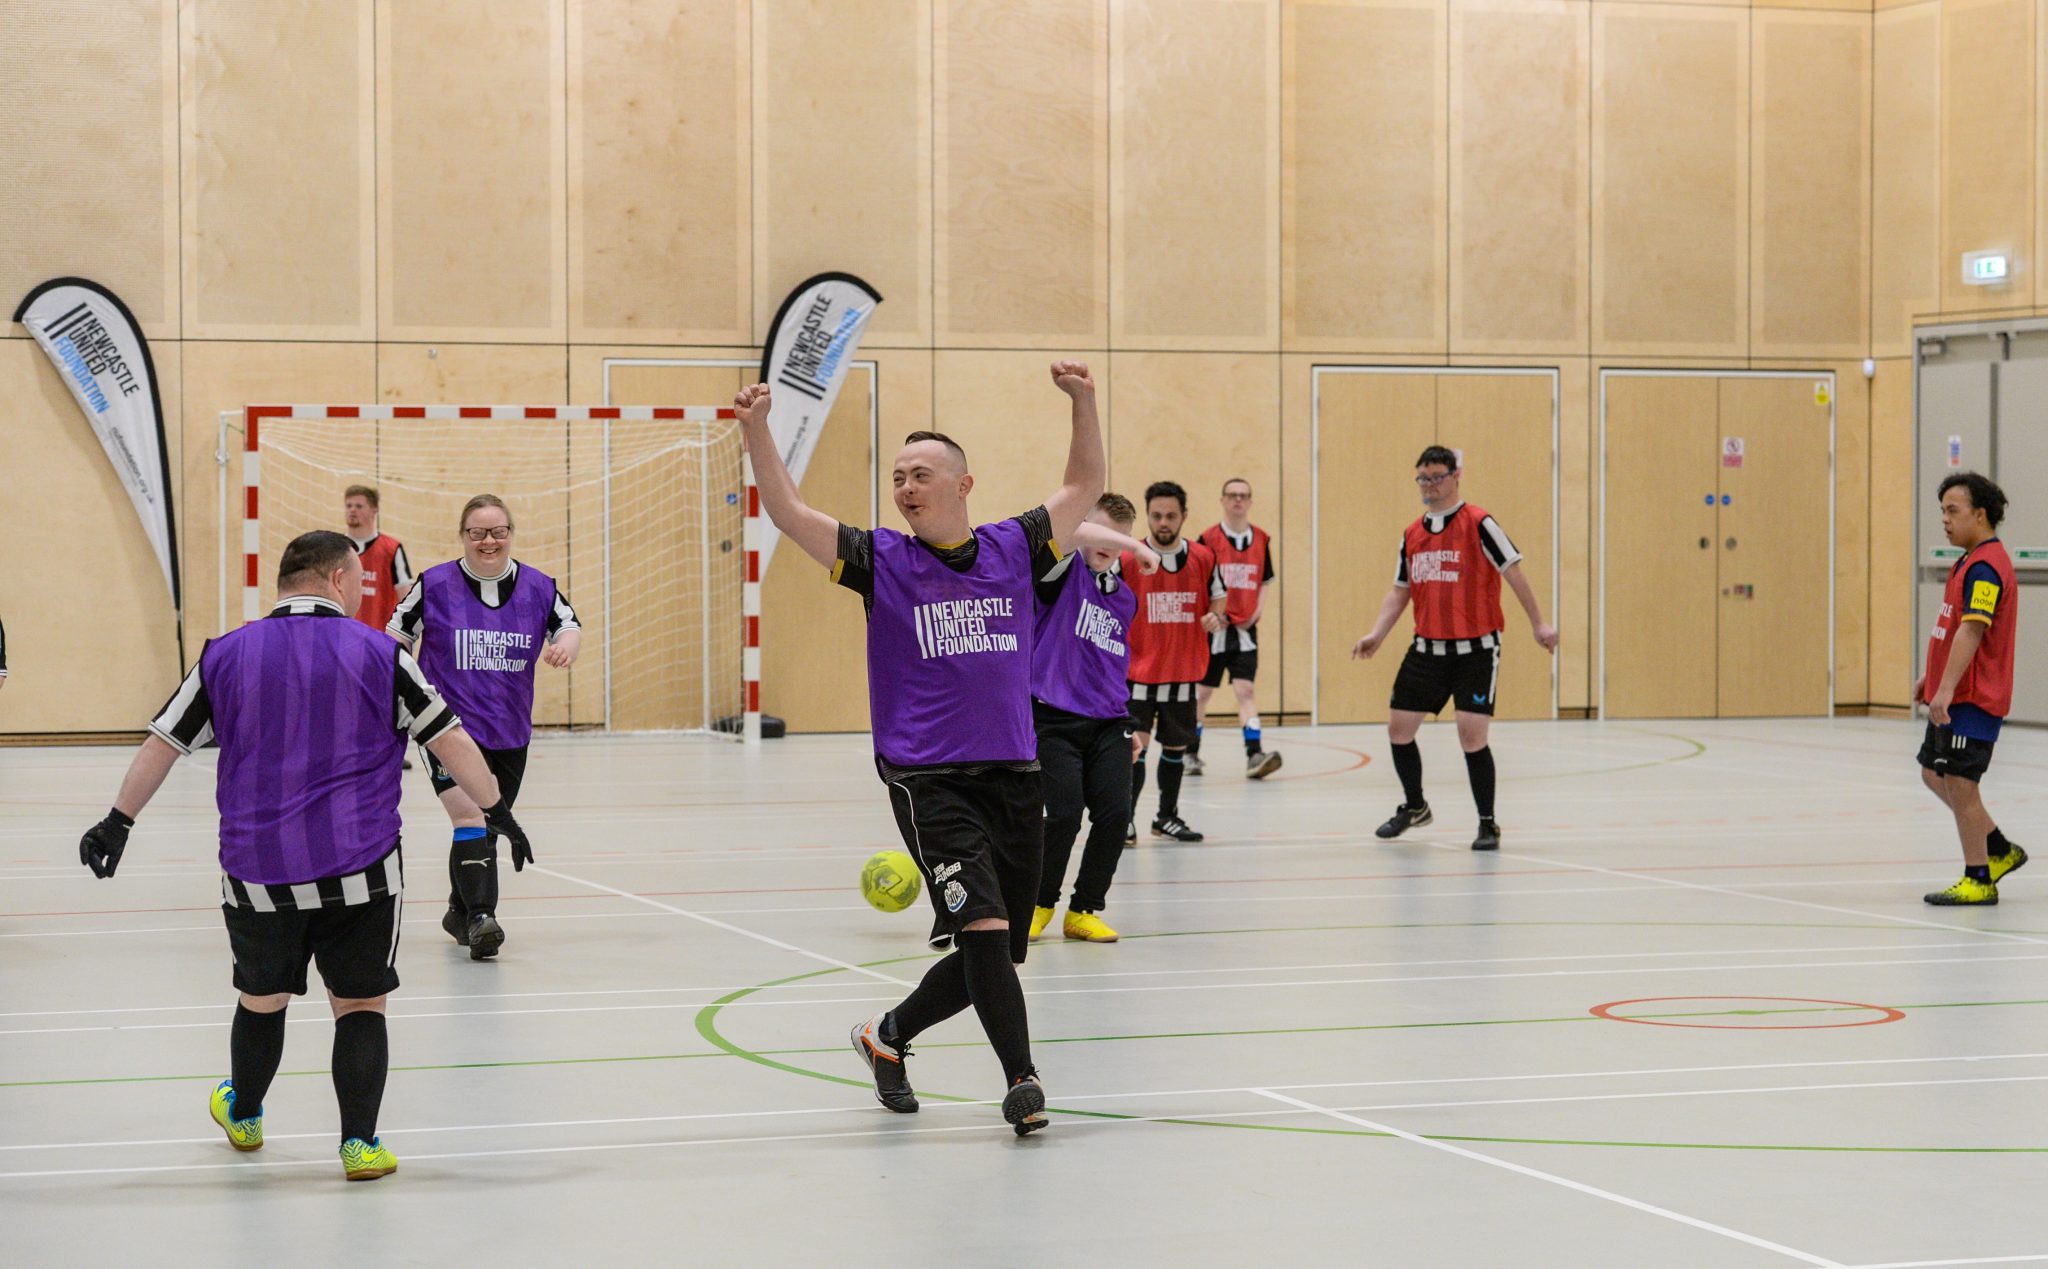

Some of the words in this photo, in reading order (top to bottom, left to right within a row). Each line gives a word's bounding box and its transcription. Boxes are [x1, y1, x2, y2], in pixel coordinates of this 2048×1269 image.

[785, 294, 832, 371] NEWCASTLE
[68, 327, 107, 376] UNITED
[82, 318, 140, 397] NEWCASTLE
[800, 330, 832, 378] UNITED
[53, 336, 111, 414] FOUNDATION
[931, 598, 1013, 621] NEWCASTLE
[1973, 597, 1994, 609] noon
[469, 629, 532, 649] NEWCASTLE
[934, 617, 986, 640] UNITED
[469, 643, 507, 659] UNITED
[936, 633, 1018, 657] FOUNDATION
[469, 656, 528, 673] FOUNDATION
